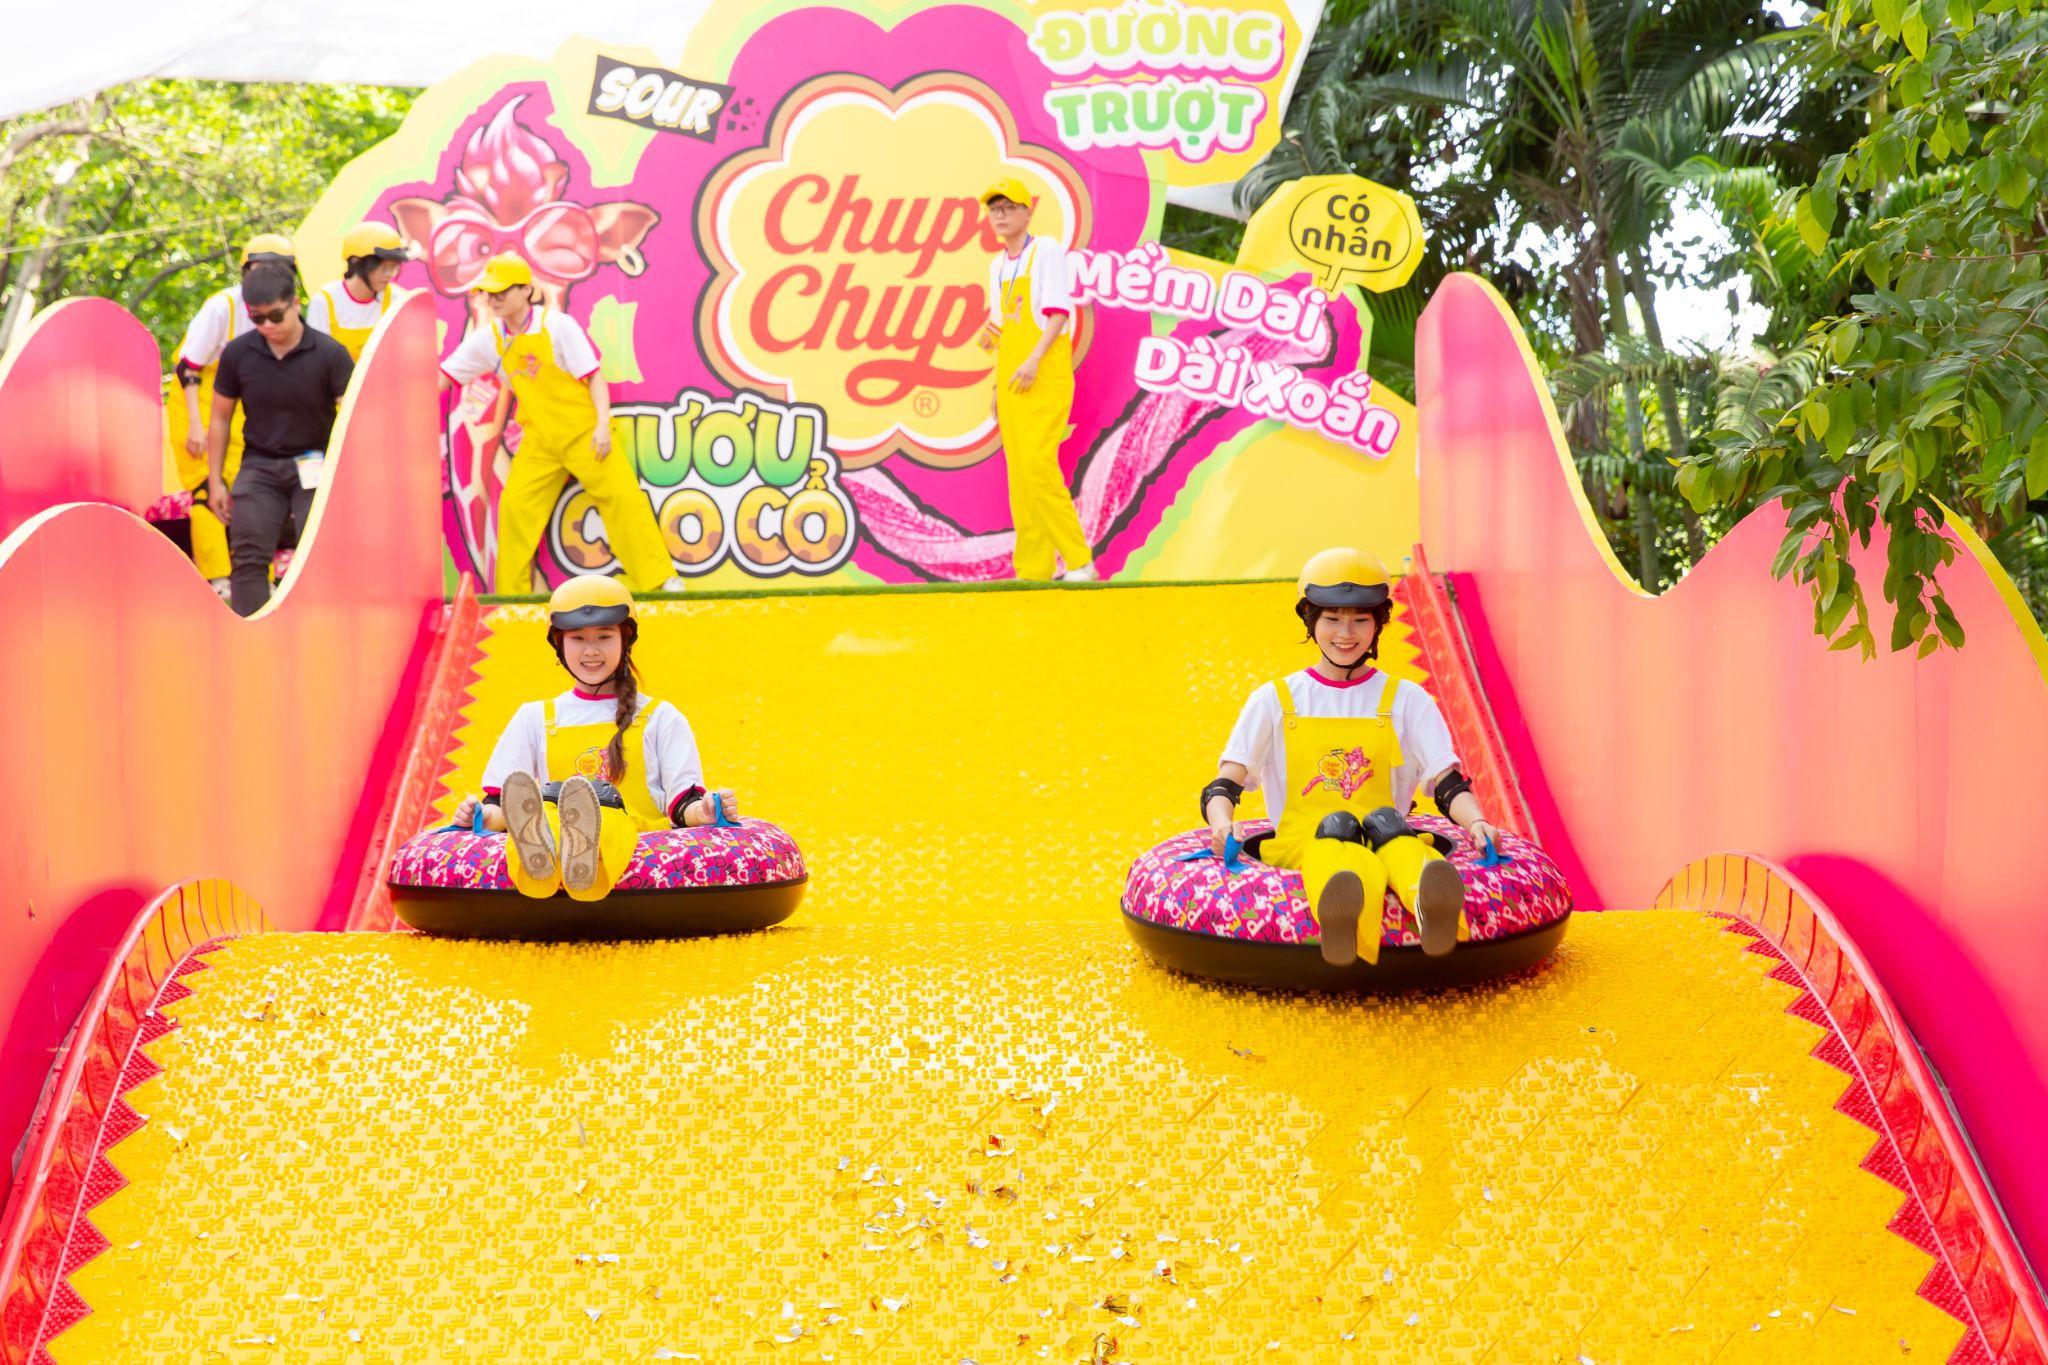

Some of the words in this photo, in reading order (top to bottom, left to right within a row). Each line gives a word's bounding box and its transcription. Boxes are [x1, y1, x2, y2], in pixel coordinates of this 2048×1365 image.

[1034, 0, 1275, 62] ĐƯỜNG
[595, 66, 724, 135] SOUR
[1049, 82, 1257, 146] TRƯỢT
[1300, 223, 1393, 262] nhân
[1326, 193, 1371, 224] Có
[1065, 240, 1212, 314] Mềm
[1221, 272, 1328, 341] Dai
[749, 262, 995, 407] Chup
[1134, 335, 1243, 397] Dài
[1246, 360, 1401, 453] Xoắn
[610, 398, 816, 487] ƯƠU
[559, 487, 725, 569] CO
[735, 457, 848, 567] CỔ
